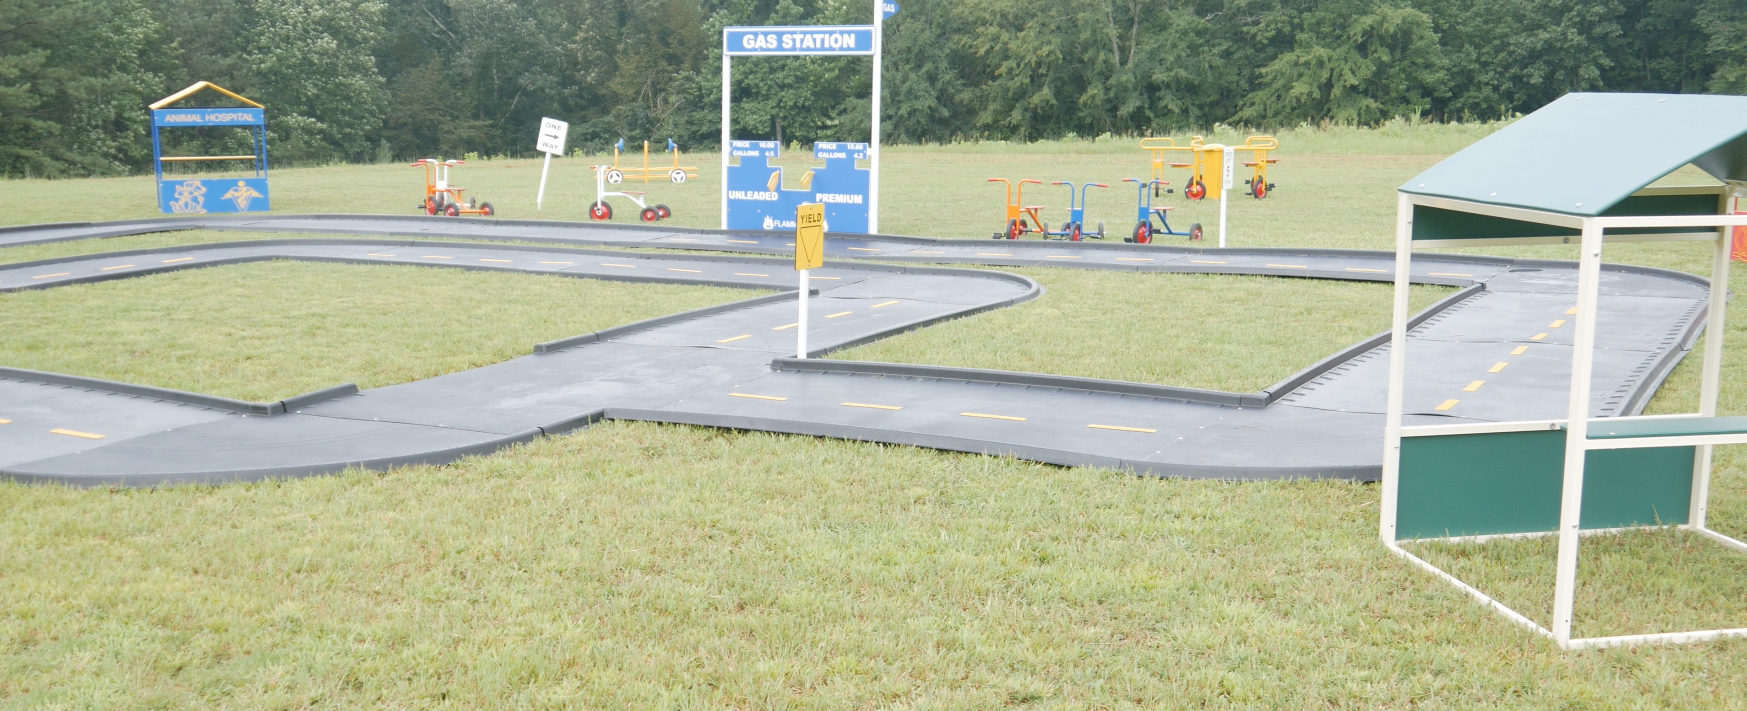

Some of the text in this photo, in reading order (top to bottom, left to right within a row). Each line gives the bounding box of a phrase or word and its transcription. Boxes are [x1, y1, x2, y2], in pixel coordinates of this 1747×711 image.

[883, 2, 895, 12] GAS
[742, 33, 856, 49] GAS STATION
[164, 113, 255, 122] ANIMAL HOSPITAL
[545, 122, 562, 131] ONE
[542, 141, 559, 150] WAY
[728, 190, 778, 201] UNLEADED
[815, 193, 863, 204] PREMIUM
[800, 213, 821, 224] YIELD
